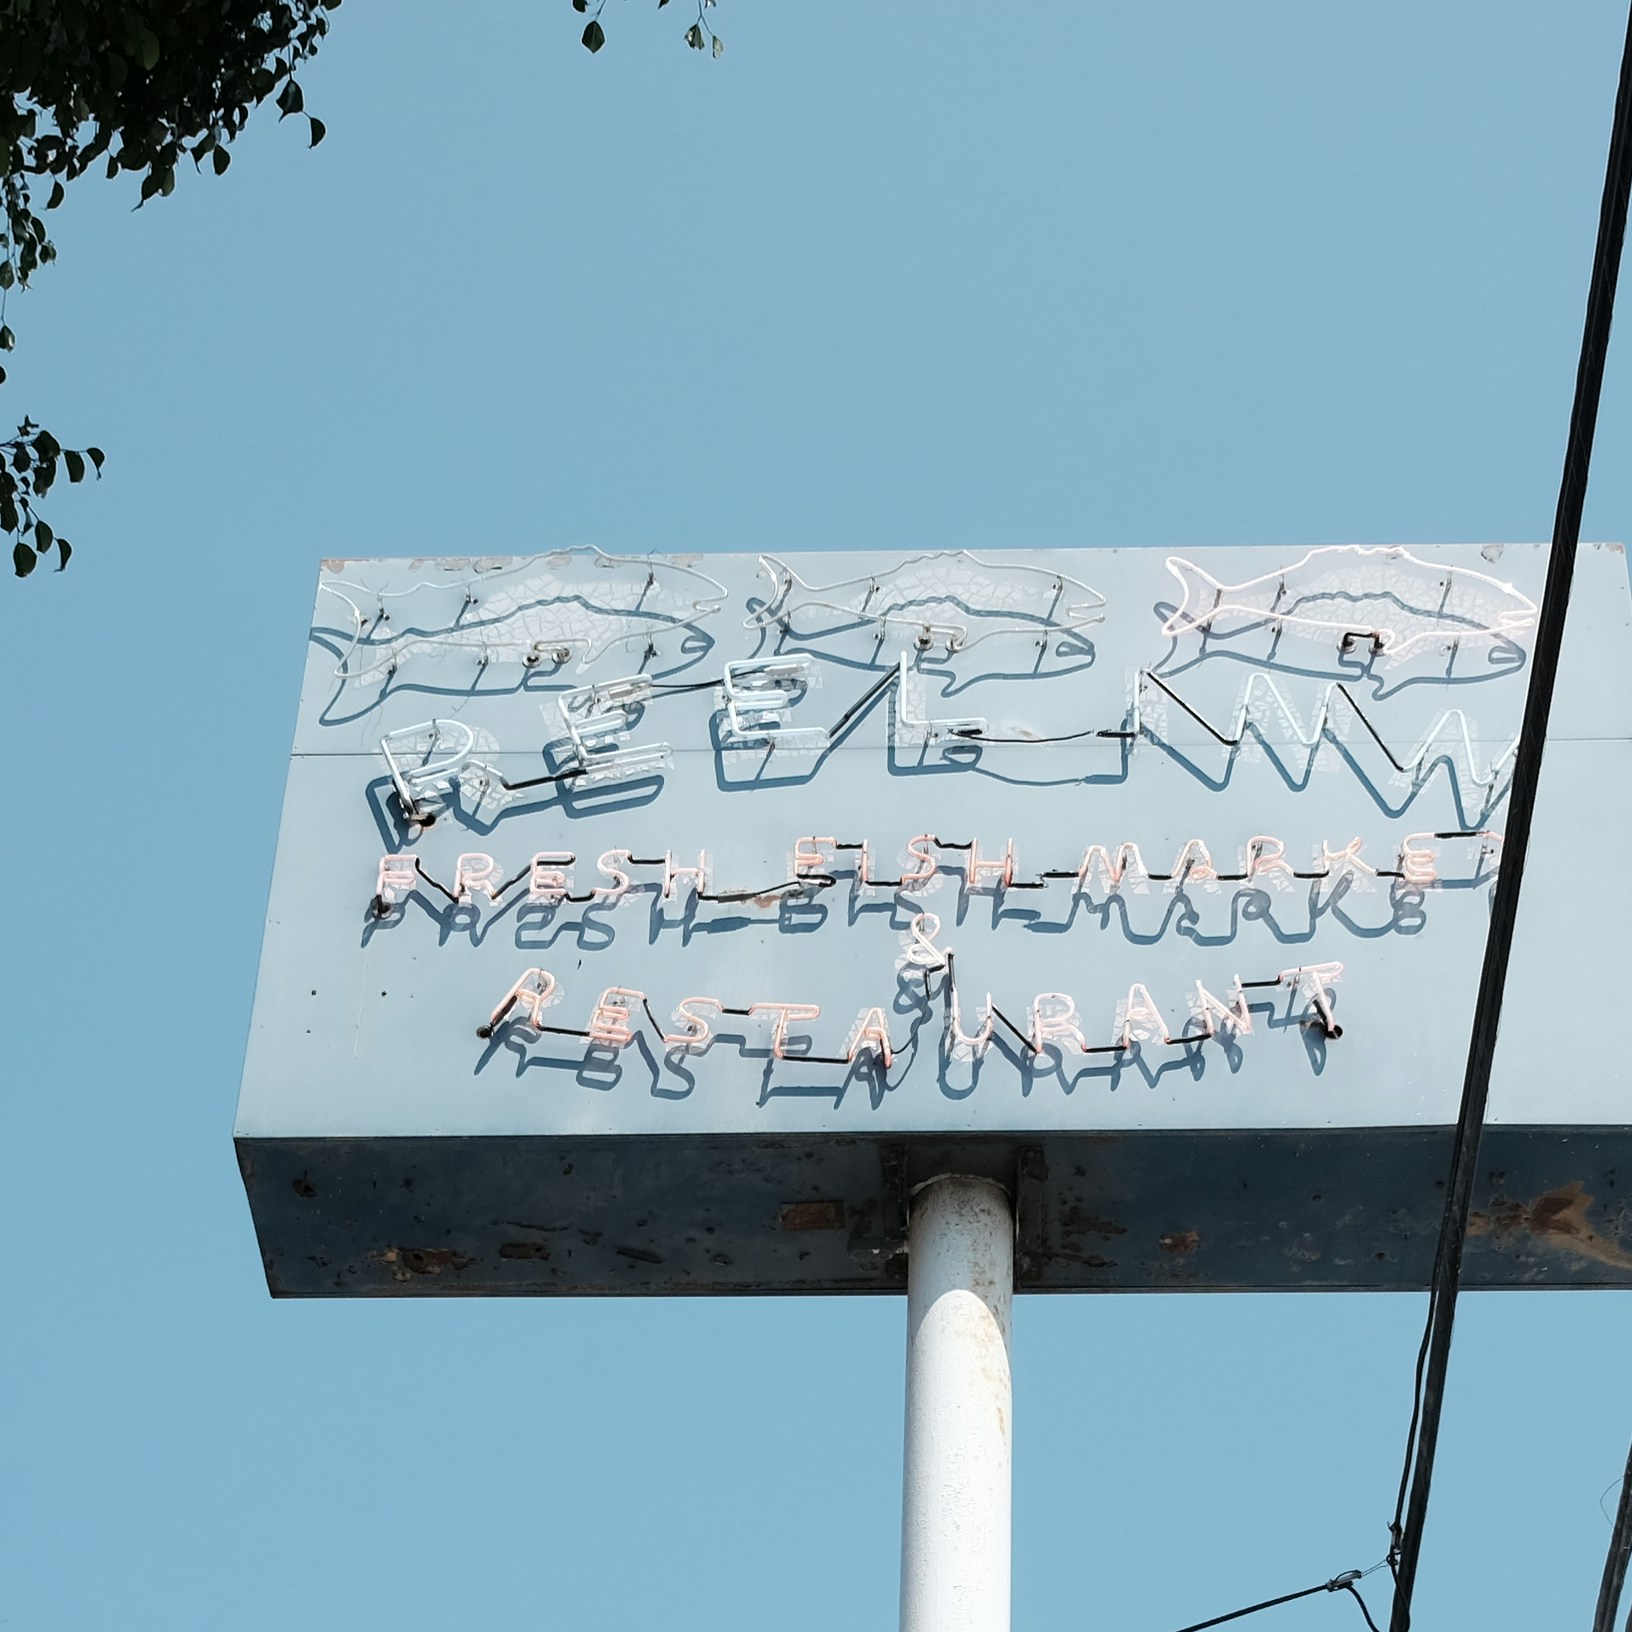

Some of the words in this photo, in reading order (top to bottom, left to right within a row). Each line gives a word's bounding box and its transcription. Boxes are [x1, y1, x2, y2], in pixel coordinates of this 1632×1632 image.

[378, 650, 990, 820] REEL
[374, 849, 710, 908] FRESH
[790, 832, 1014, 889] FISH
[1077, 830, 1506, 886] MARKE
[906, 911, 960, 968] &
[478, 960, 1346, 1070] RESTAURANT
